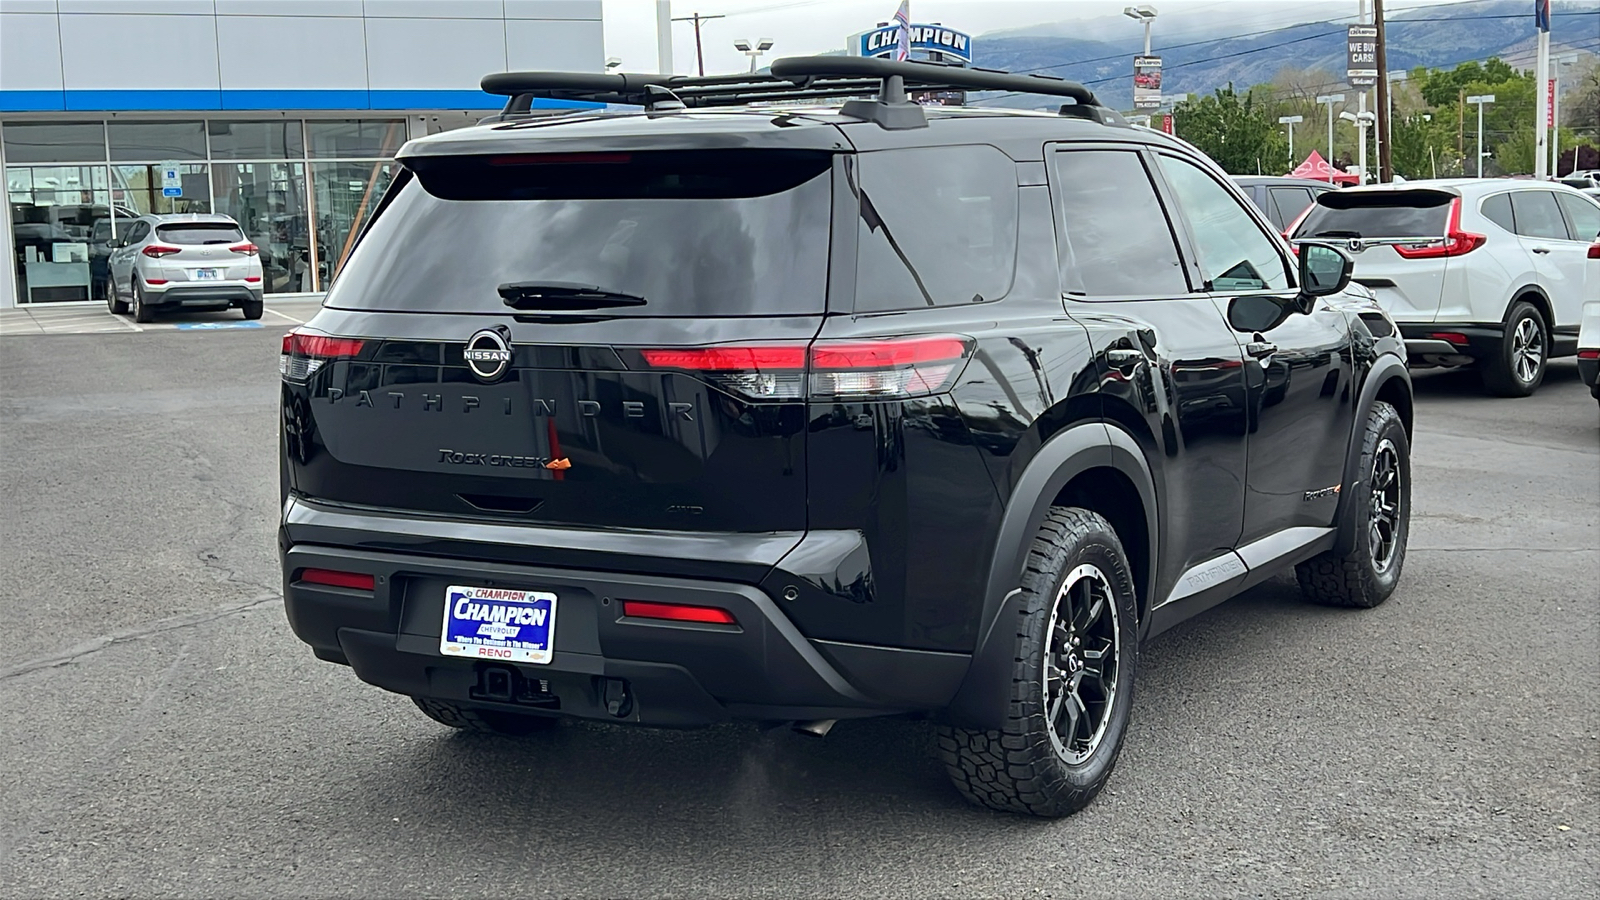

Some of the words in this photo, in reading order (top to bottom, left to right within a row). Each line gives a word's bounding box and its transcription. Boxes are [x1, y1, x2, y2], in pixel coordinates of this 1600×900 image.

[1349, 42, 1362, 52] WE
[1363, 42, 1376, 52] BUY
[1352, 53, 1374, 62] CARS!
[464, 350, 509, 361] NISSAN
[327, 387, 693, 421] PATHFINDER
[439, 449, 487, 466] ROCK
[490, 454, 548, 469] CREEK
[1186, 559, 1243, 588] PATHFINDER
[475, 589, 526, 601] CHAMPION
[453, 597, 547, 626] CHAMPION
[480, 626, 517, 635] CHEVROLET
[479, 648, 512, 658] RENO
